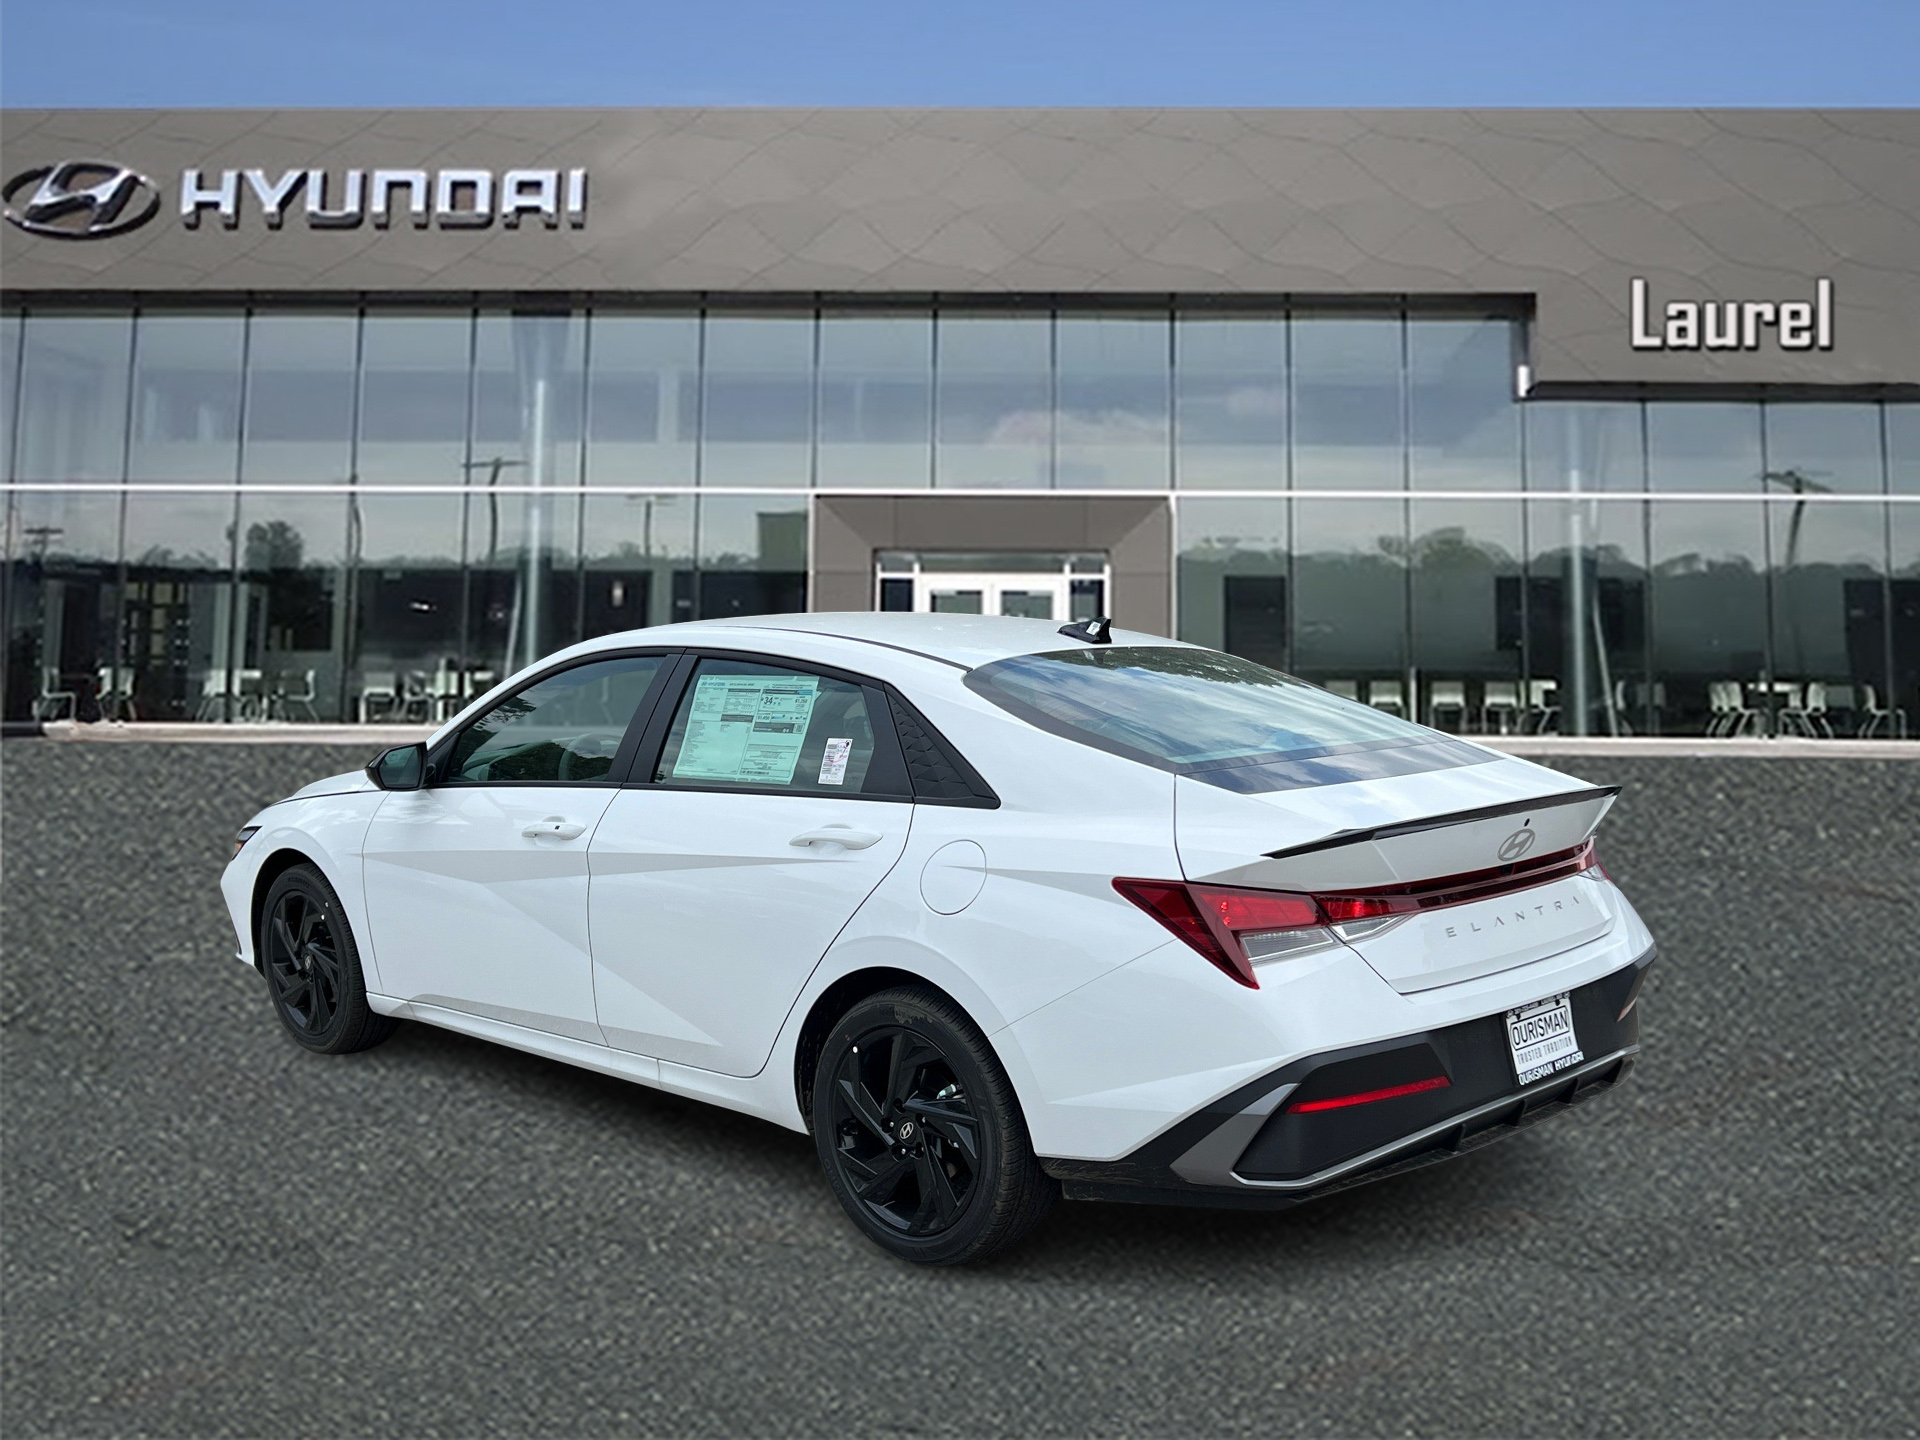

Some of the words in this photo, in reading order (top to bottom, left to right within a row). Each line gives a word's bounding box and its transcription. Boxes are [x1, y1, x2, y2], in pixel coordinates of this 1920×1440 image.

[180, 168, 587, 231] HYUNDAI
[1631, 278, 1833, 350] Laurel
[1445, 895, 1580, 938] ELANTRA
[1513, 1010, 1569, 1046] OURISMAN
[1516, 1048, 1542, 1065] TRUSTED
[1544, 1035, 1573, 1055] TRADITION
[1518, 1062, 1554, 1086] OURISMAN
